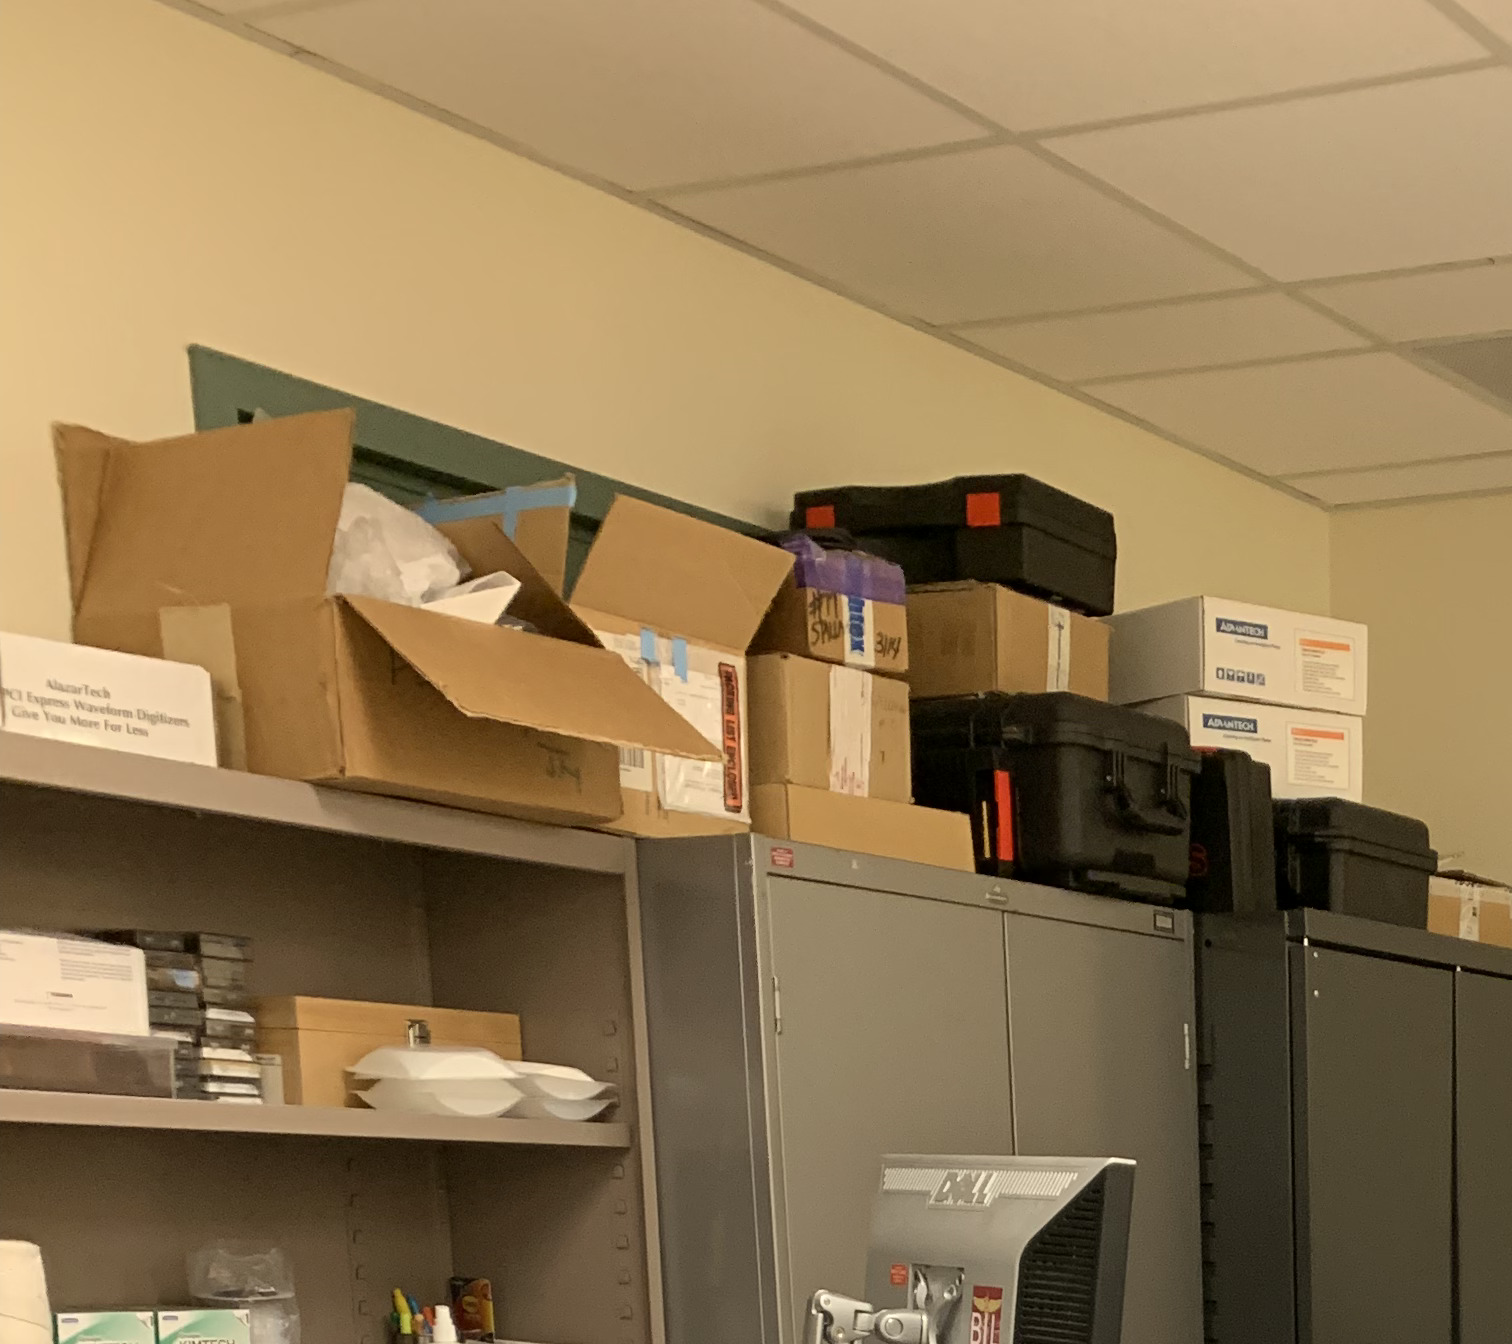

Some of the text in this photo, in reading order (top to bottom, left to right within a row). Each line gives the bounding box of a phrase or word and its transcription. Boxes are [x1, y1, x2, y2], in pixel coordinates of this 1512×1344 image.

[1219, 620, 1265, 638] ADVANTECH
[46, 679, 111, 700] AlazarTech
[27, 691, 70, 711] Express
[74, 699, 133, 719] Waveform
[137, 708, 191, 728] Digitizers
[11, 705, 149, 738] Give You More For Less
[1207, 717, 1255, 732] ADVANTECH
